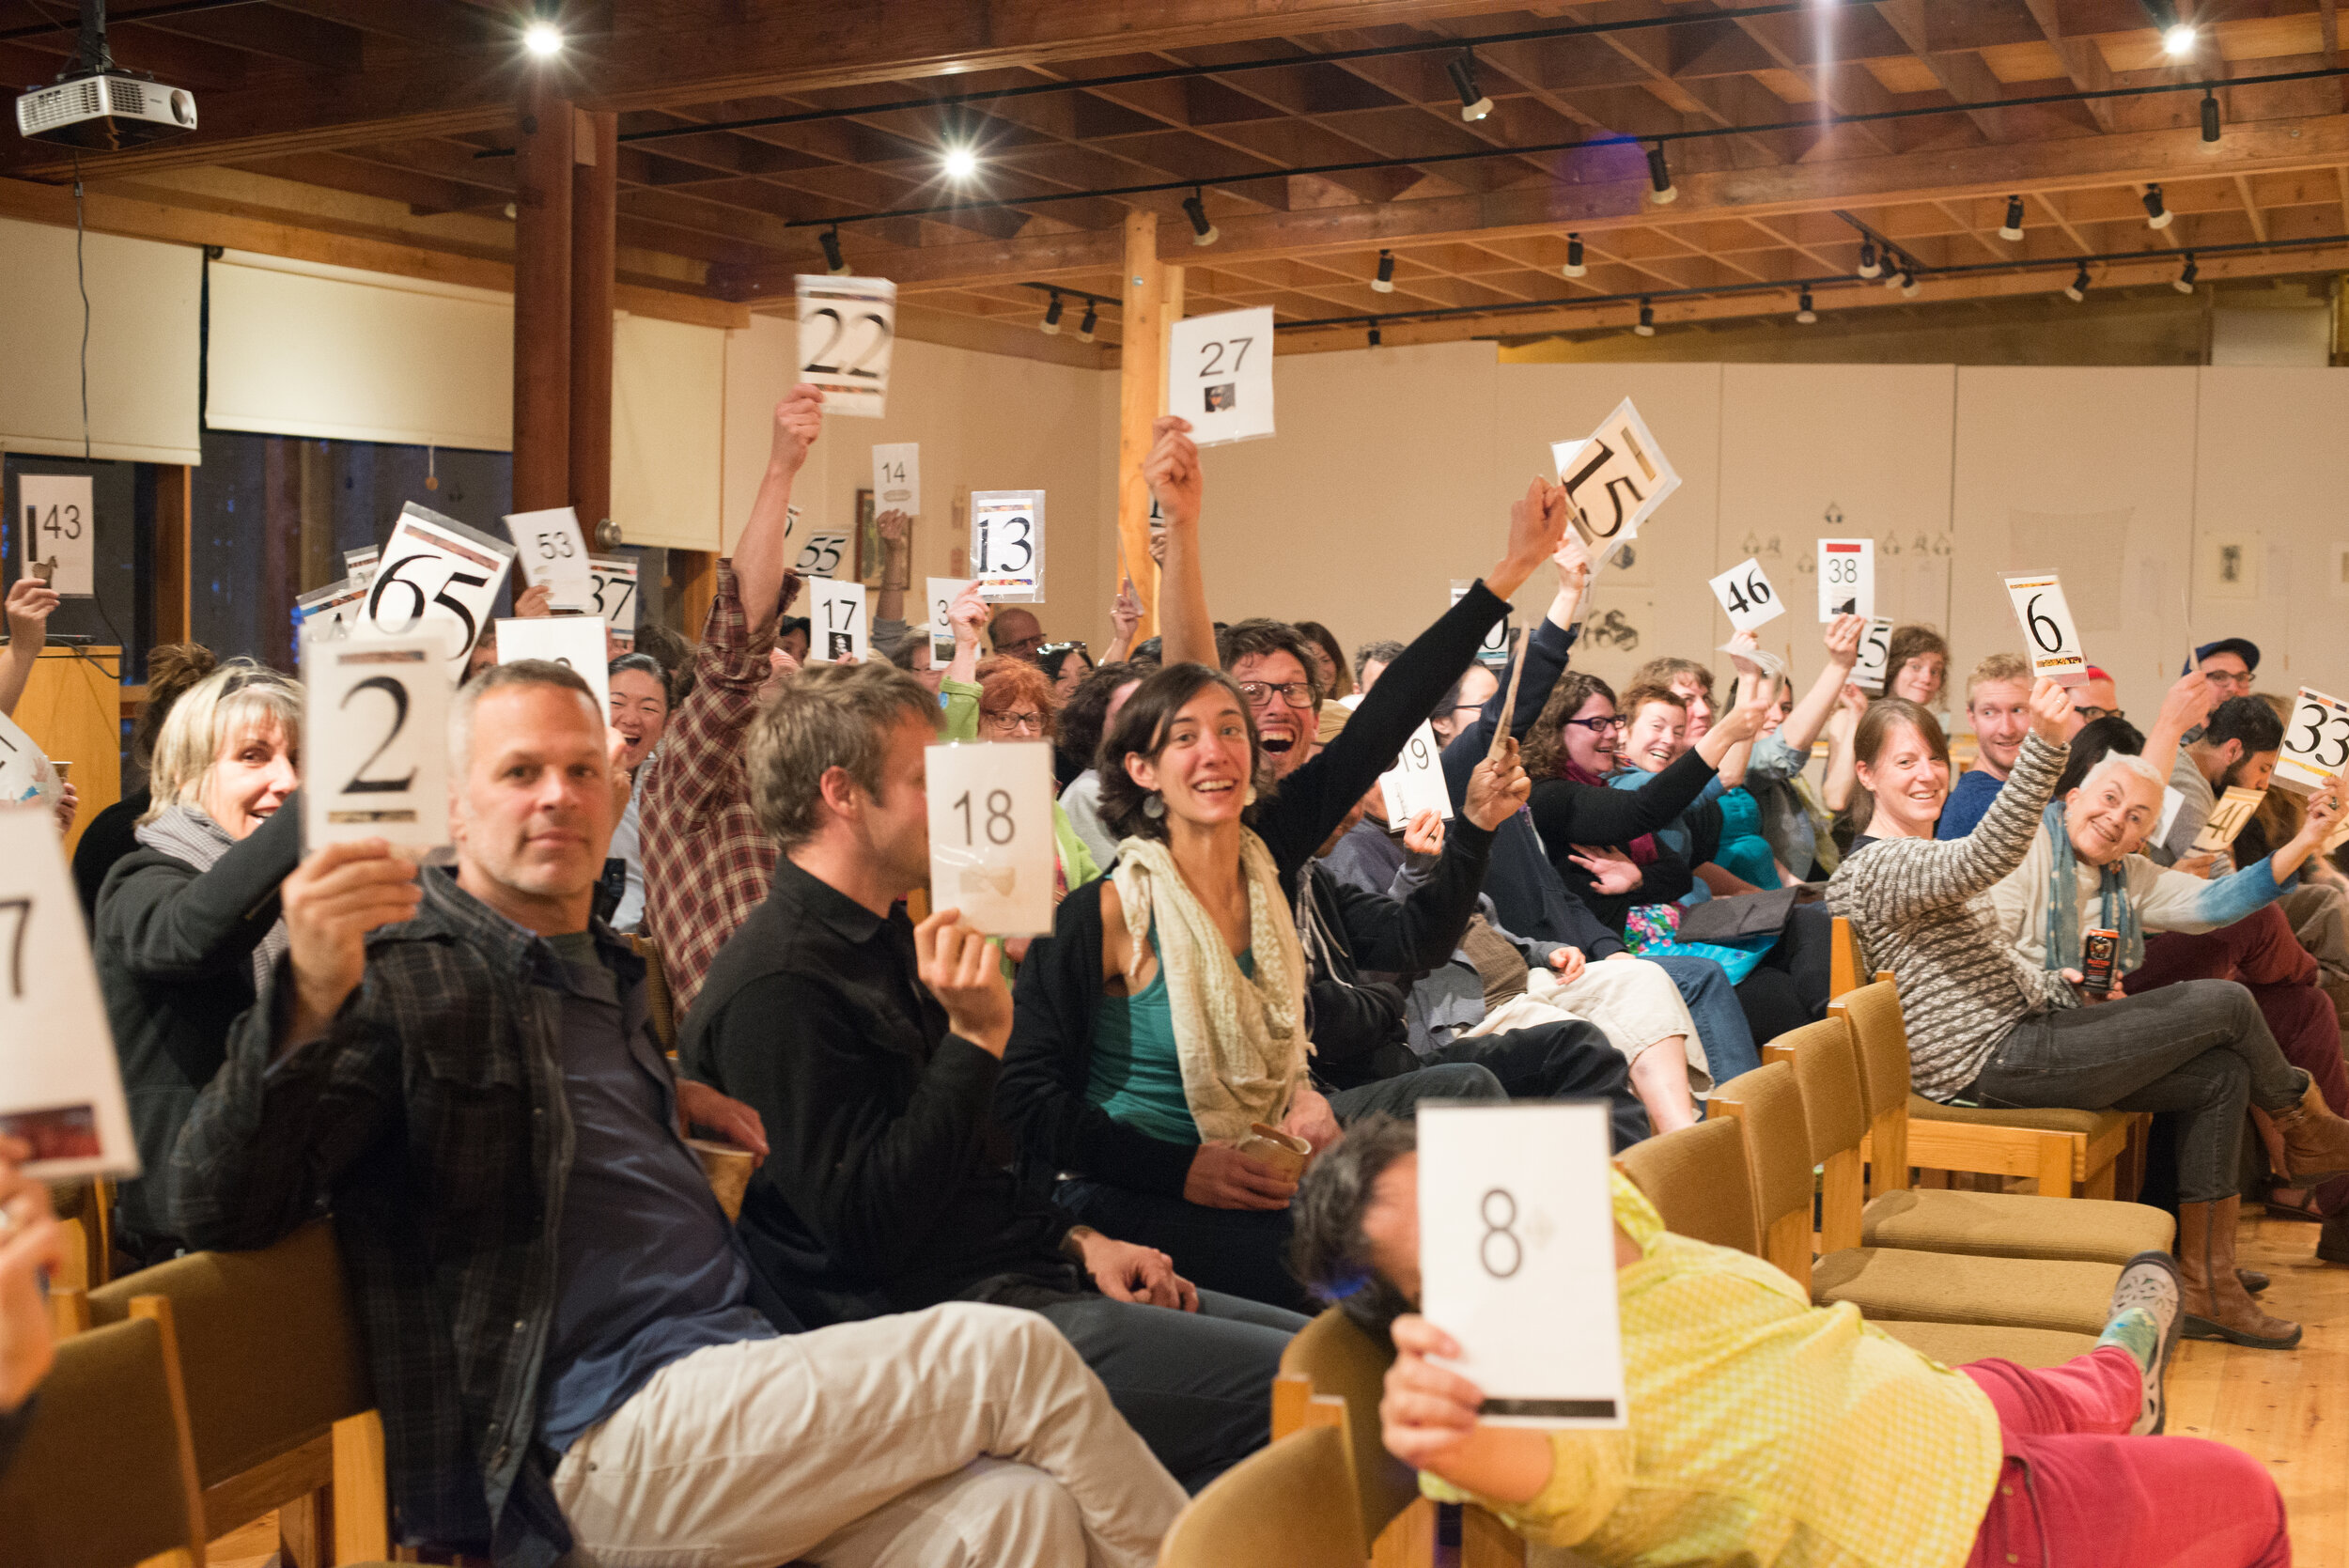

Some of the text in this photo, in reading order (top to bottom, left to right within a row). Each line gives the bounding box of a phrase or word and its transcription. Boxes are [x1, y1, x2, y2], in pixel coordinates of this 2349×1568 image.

[800, 307, 893, 379] 22
[1199, 337, 1253, 378] 27
[881, 461, 907, 484] 14
[1562, 438, 1644, 538] 15
[43, 504, 82, 539] 43
[537, 531, 574, 559] 53
[796, 536, 847, 571] 55
[978, 517, 1033, 573] 13
[1728, 567, 1771, 613] 46
[1828, 558, 1858, 583] 38
[369, 554, 490, 661] 65
[591, 574, 636, 621] 37
[823, 598, 857, 630] 17
[937, 599, 951, 627] 3
[2027, 593, 2062, 653] 6
[1855, 627, 1890, 668] 5
[339, 675, 418, 795] 2
[1399, 737, 1429, 773] 19
[2284, 704, 2349, 768] 33
[953, 789, 1015, 846] 18
[2206, 801, 2254, 844] 40
[1480, 1186, 1523, 1281] 8
